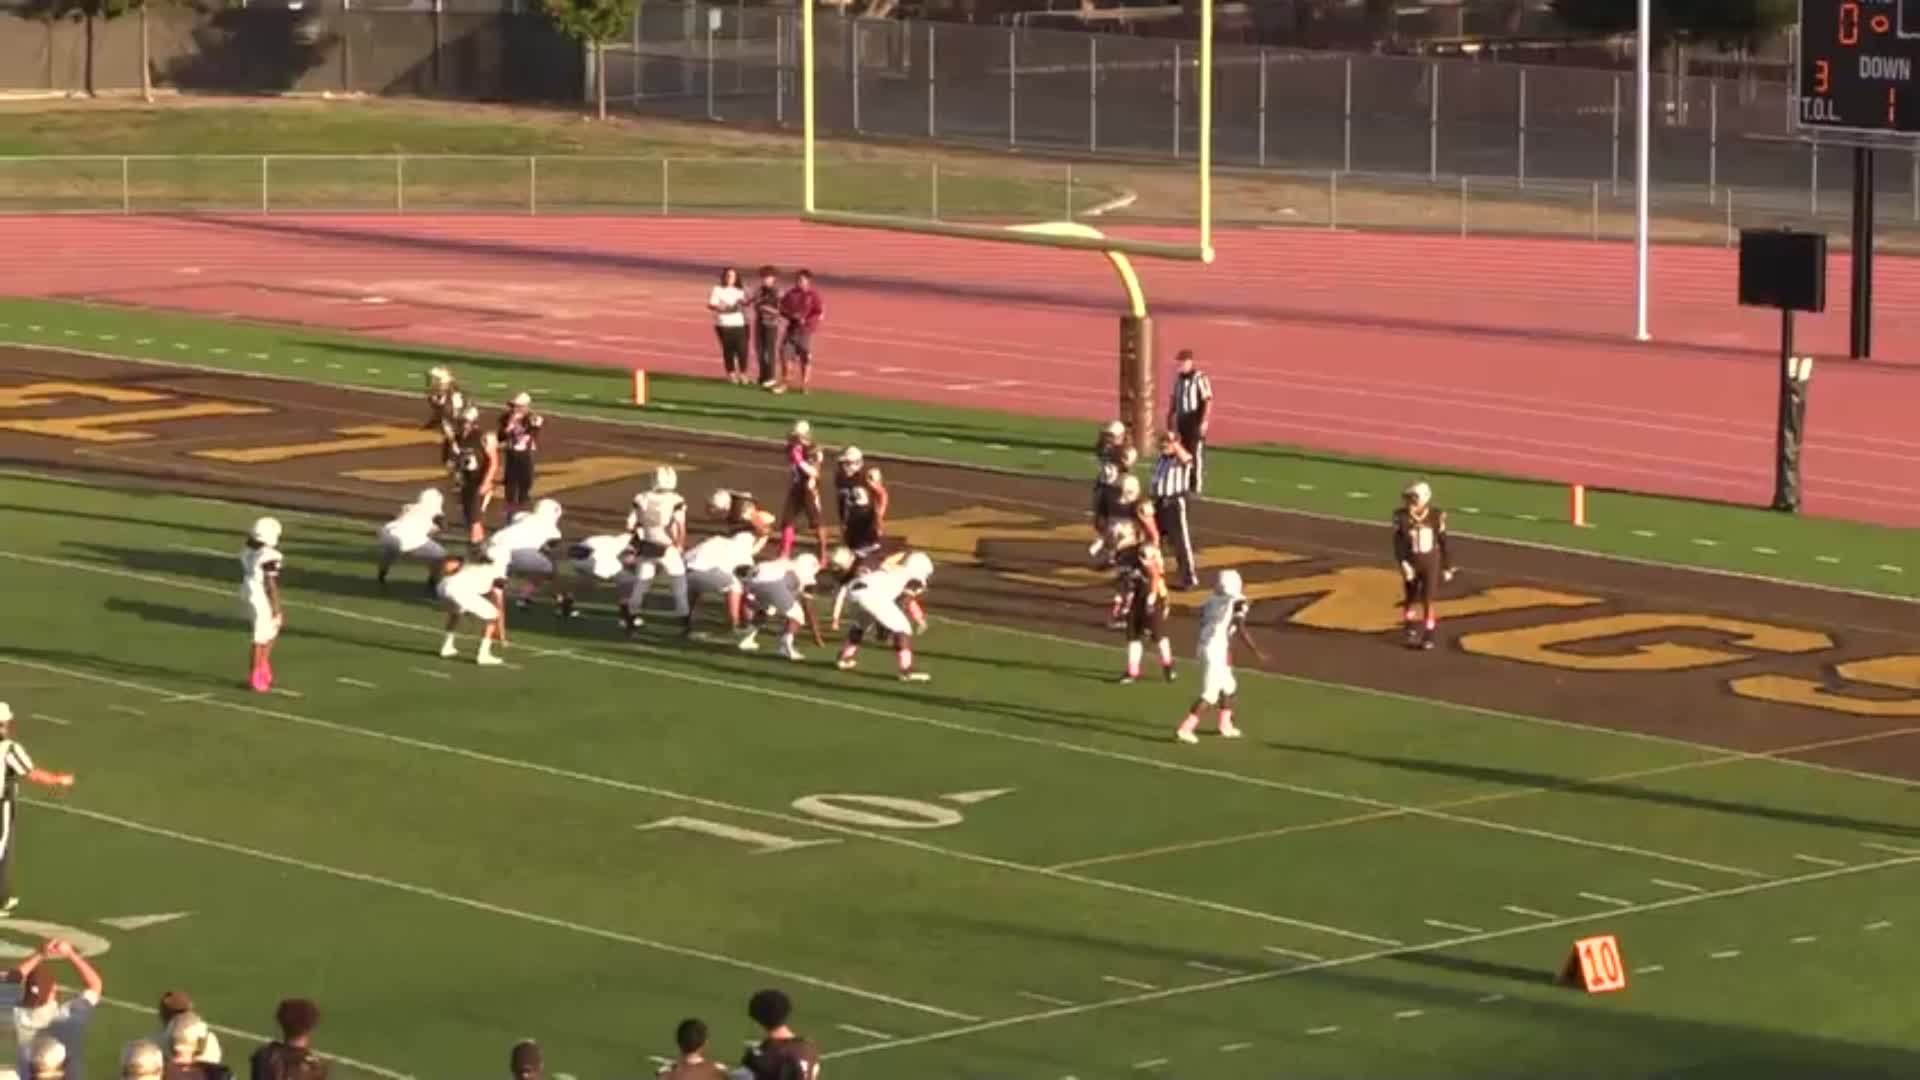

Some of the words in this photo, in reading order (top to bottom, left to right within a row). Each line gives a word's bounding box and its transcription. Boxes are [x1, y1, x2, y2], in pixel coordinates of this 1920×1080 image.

[1815, 60, 1829, 92] 3
[1859, 56, 1910, 80] DOWN
[1583, 941, 1619, 986] 10
